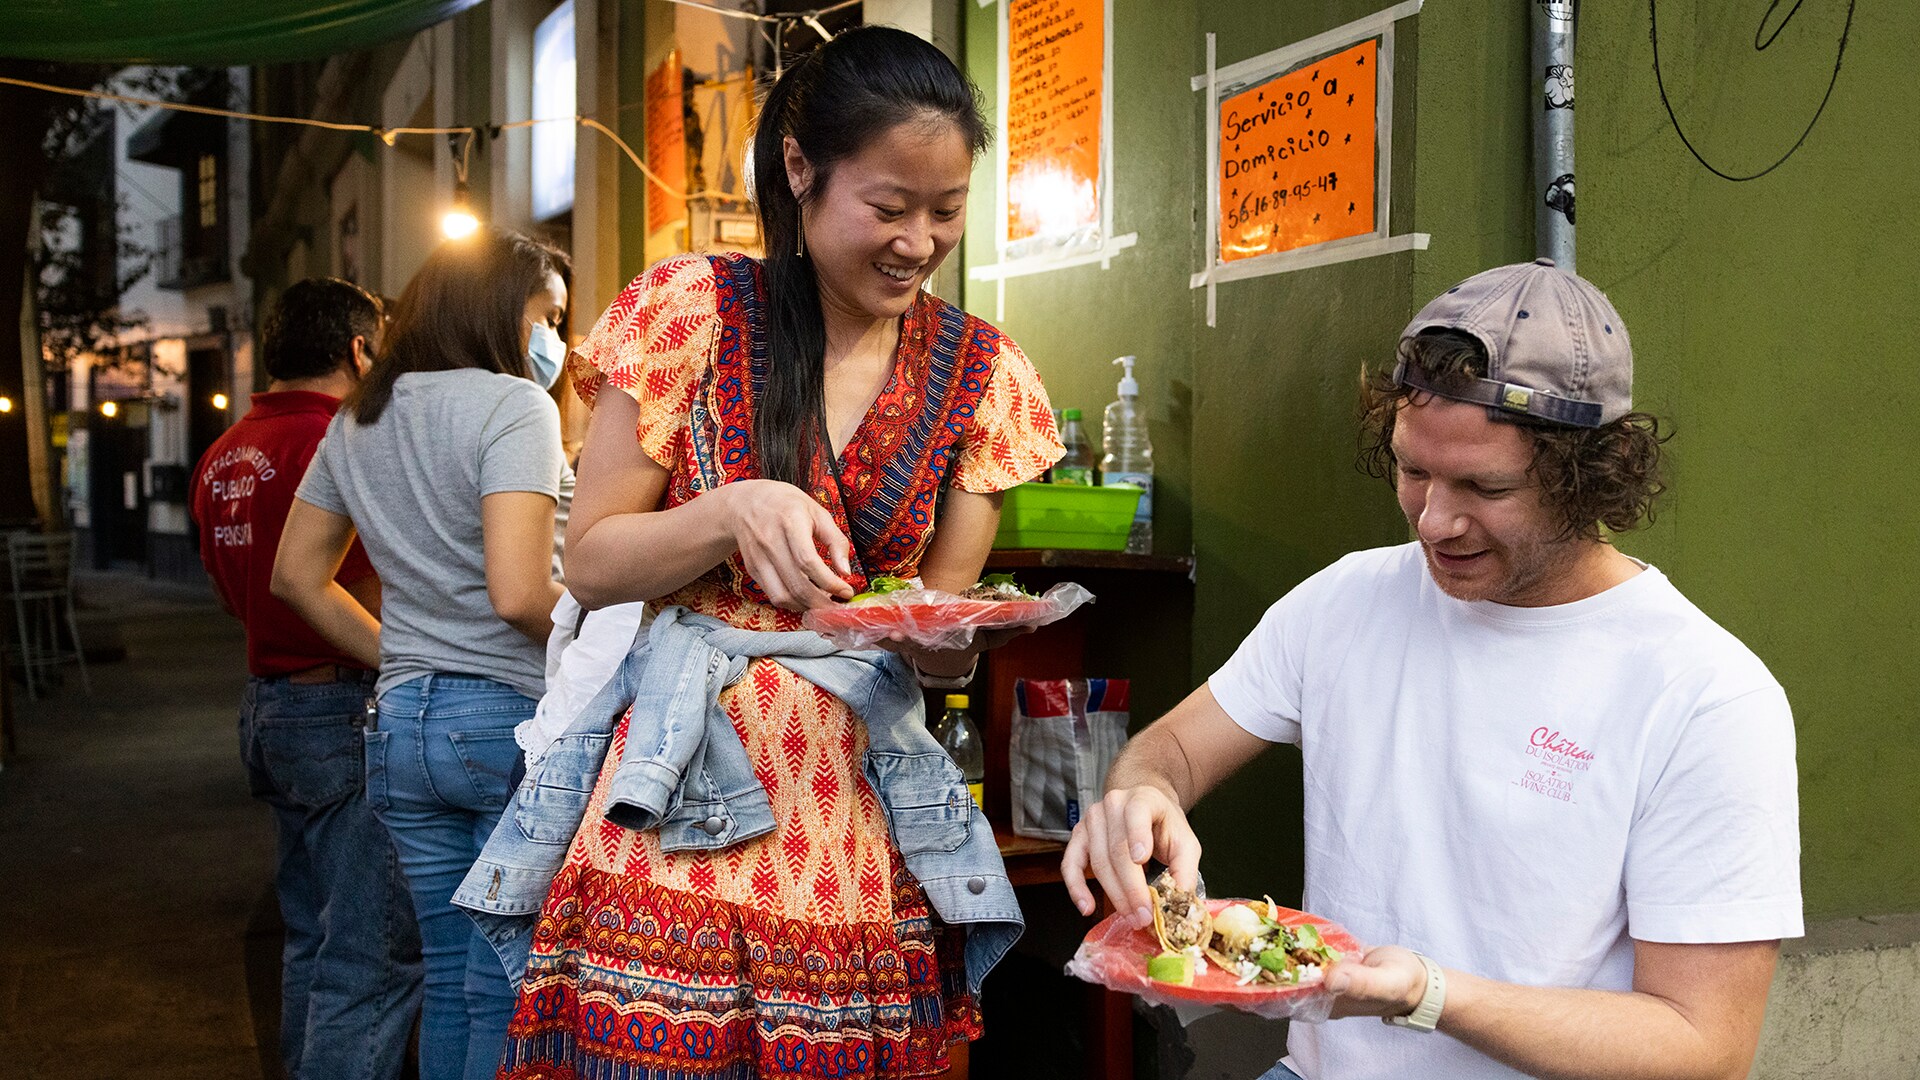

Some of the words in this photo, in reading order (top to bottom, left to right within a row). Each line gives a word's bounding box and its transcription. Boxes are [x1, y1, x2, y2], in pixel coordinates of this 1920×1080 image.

[1226, 91, 1310, 141] Servicio
[1324, 78, 1337, 96] a
[1225, 130, 1330, 178] Domicilio
[203, 446, 276, 486] ESTACIONENTO
[1525, 745, 1543, 758] DU
[1543, 752, 1592, 771] ISOLATION
[1521, 778, 1547, 794] WINE
[1547, 788, 1571, 802] CLUB
[1524, 770, 1574, 791] ISOLATION
